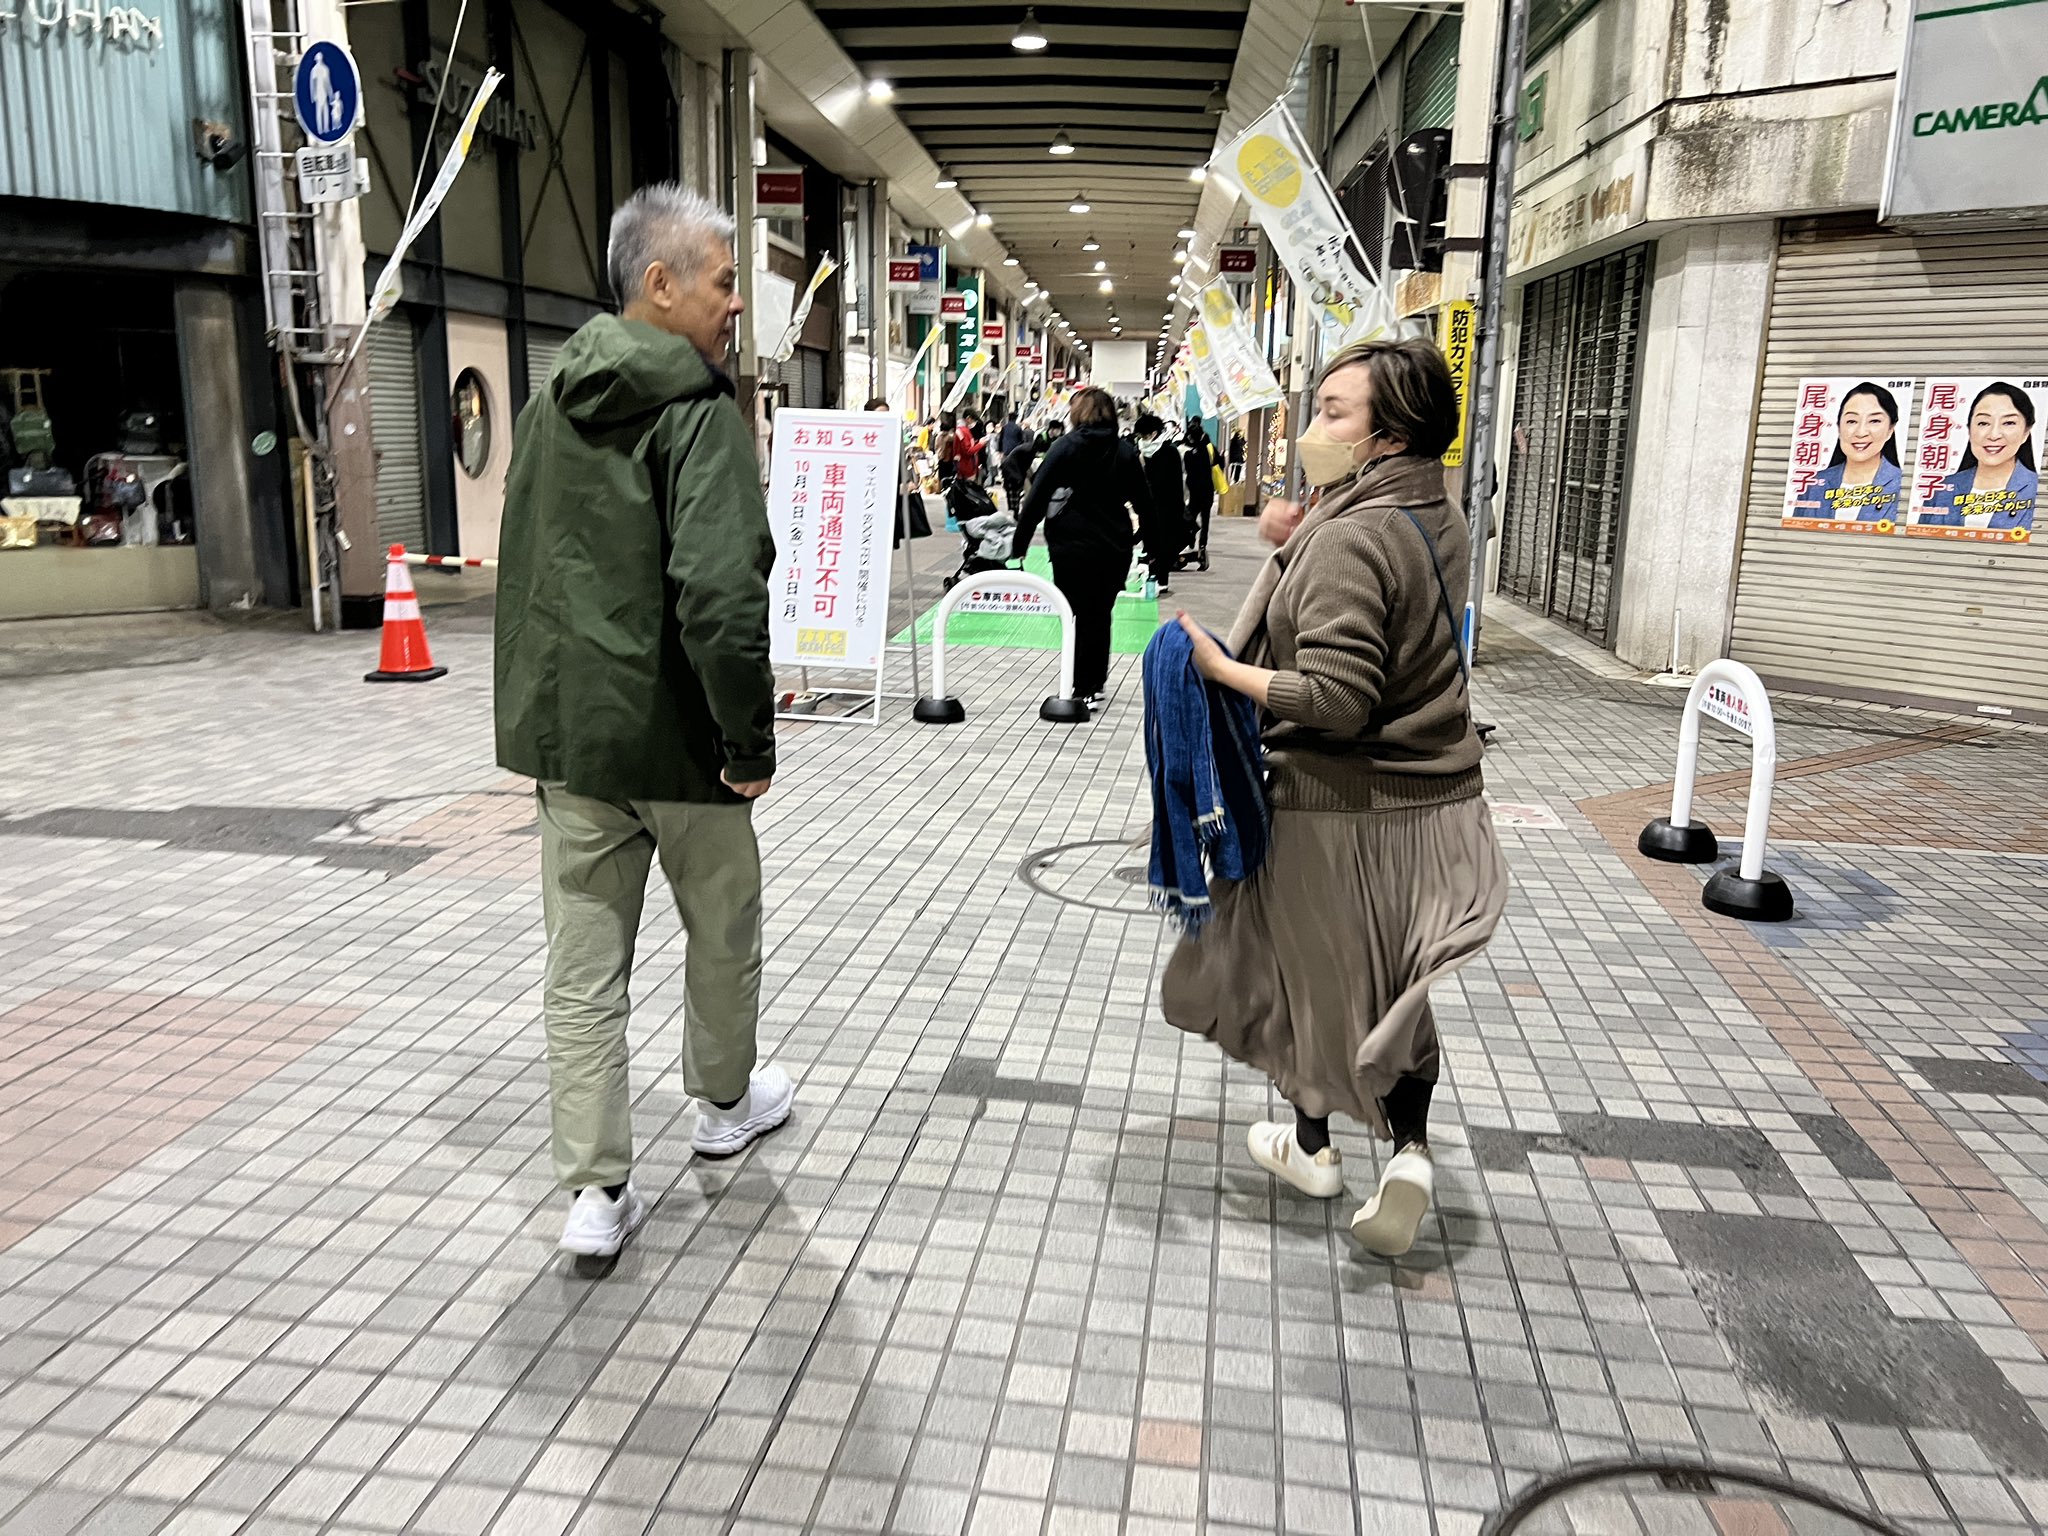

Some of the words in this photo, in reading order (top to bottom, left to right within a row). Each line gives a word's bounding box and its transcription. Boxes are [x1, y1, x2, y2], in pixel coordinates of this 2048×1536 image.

[794, 428, 879, 448] お知らせ
[1792, 385, 1827, 493] 尾身朝子
[1918, 385, 1957, 499] 尾身朝子
[813, 463, 848, 618] 車両通行不可
